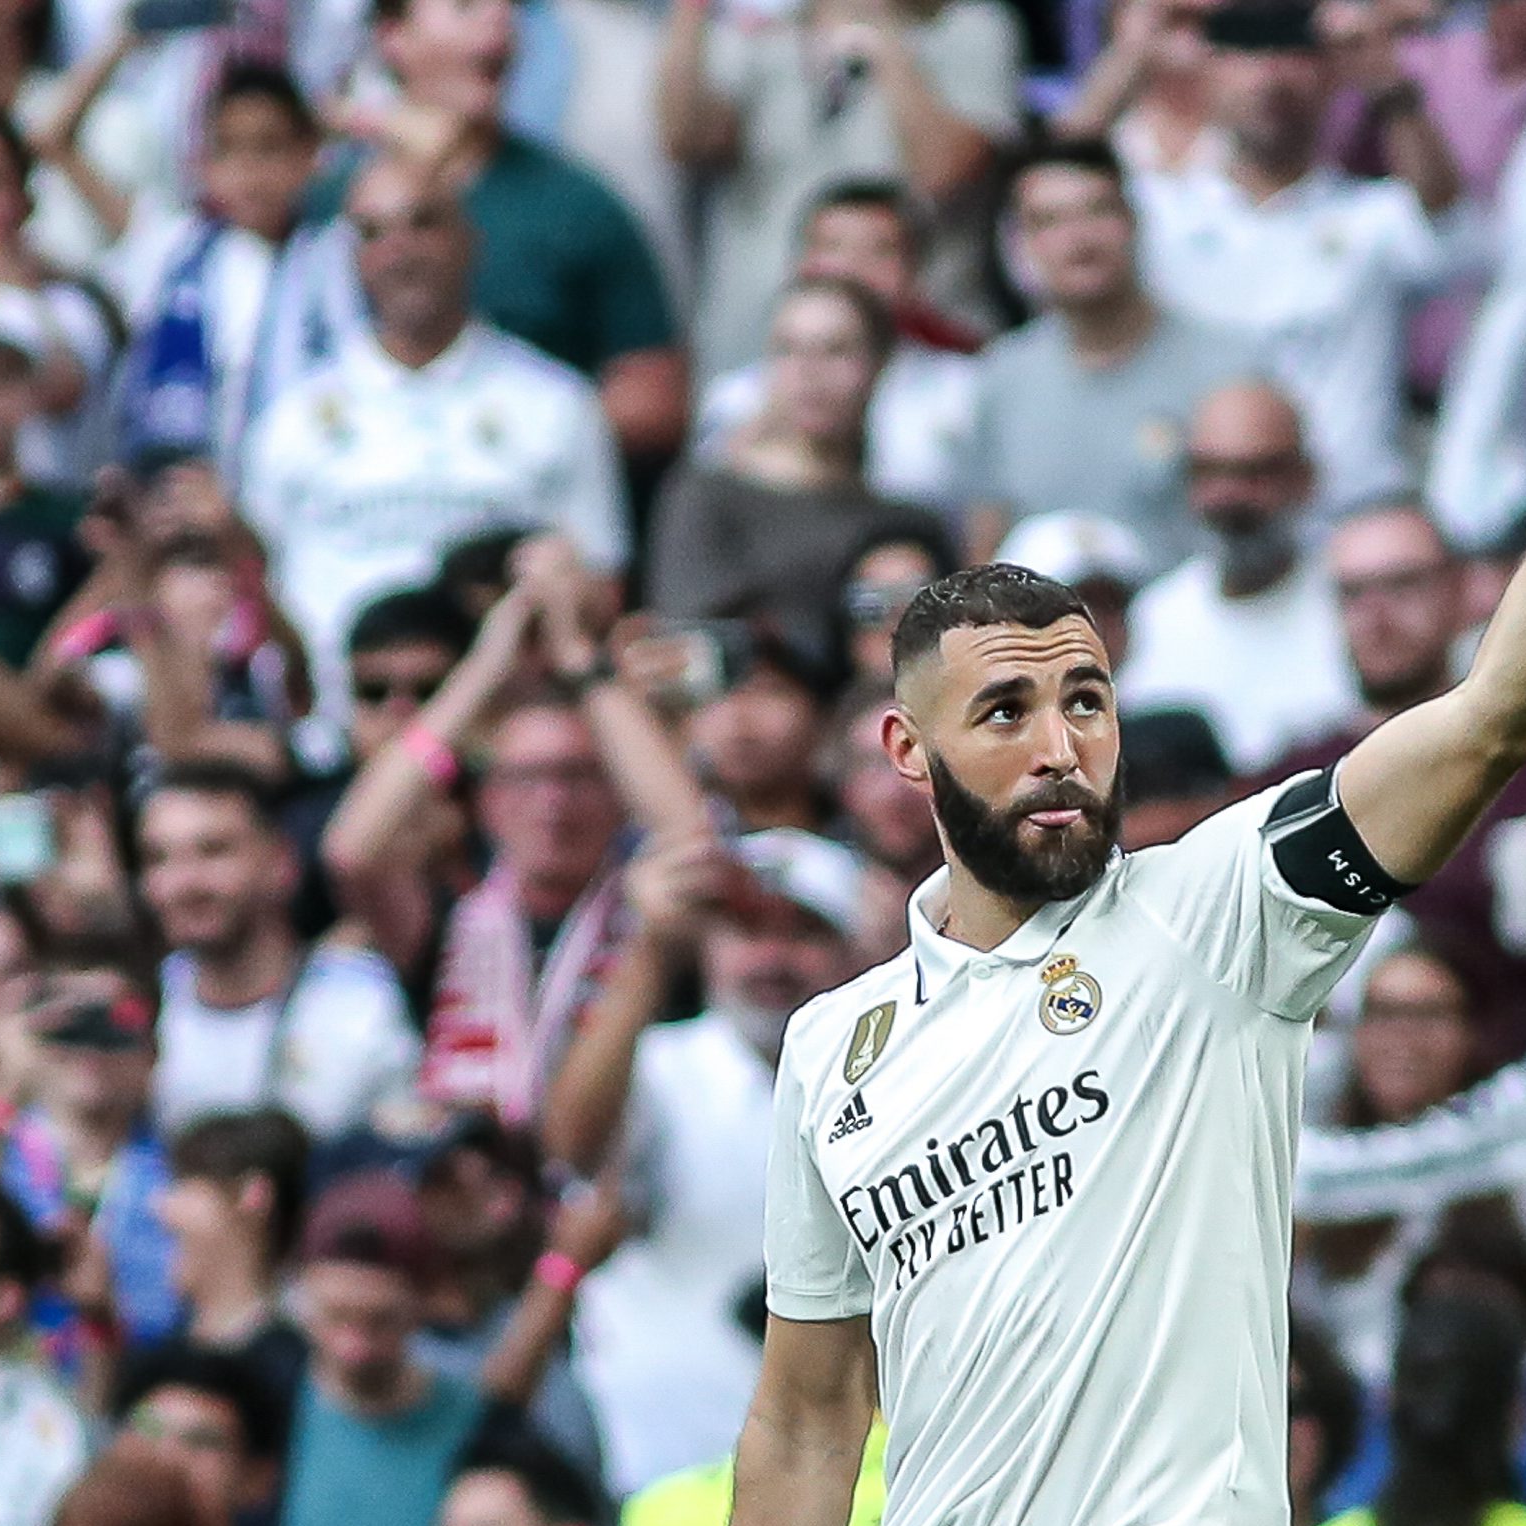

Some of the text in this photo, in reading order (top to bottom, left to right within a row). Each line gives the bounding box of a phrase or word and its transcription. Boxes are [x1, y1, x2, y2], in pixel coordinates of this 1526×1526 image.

[839, 1070, 1109, 1254] Emirates
[889, 1152, 1074, 1291] FLY BETTER
